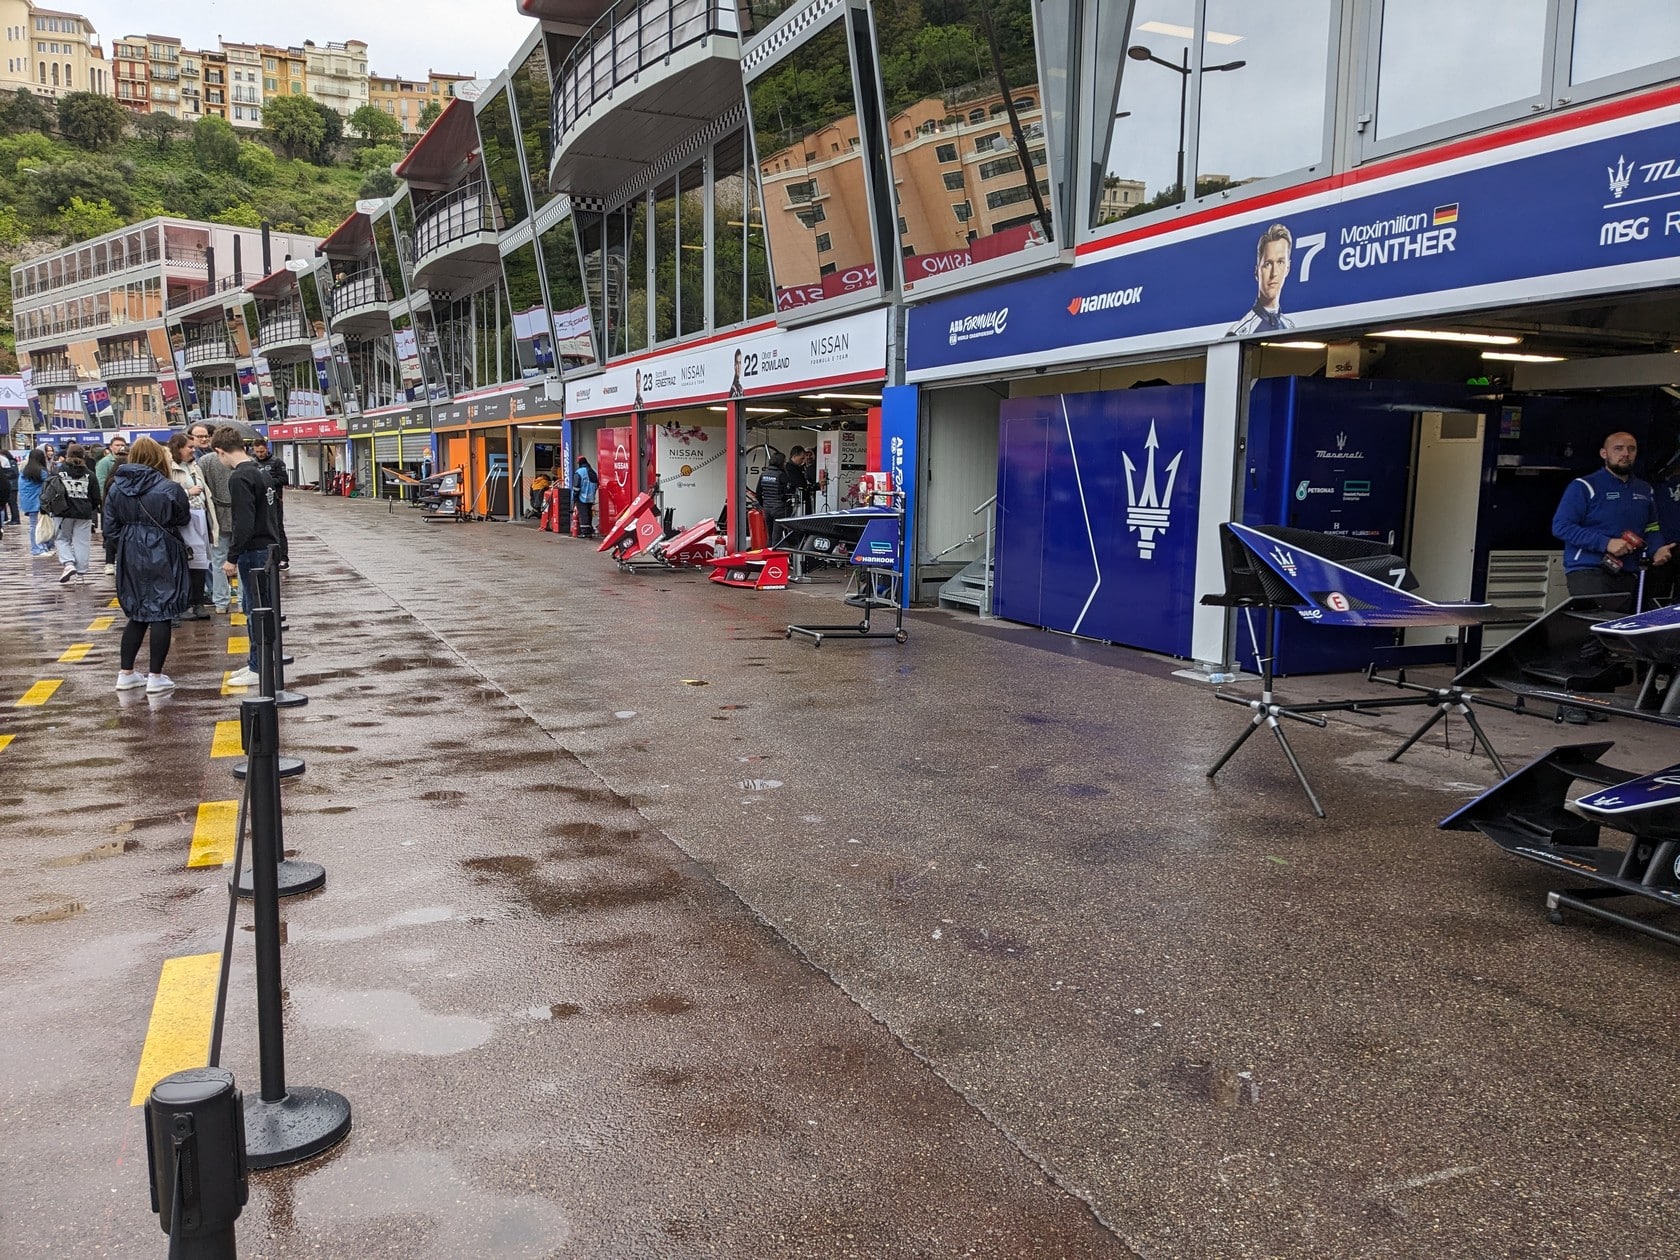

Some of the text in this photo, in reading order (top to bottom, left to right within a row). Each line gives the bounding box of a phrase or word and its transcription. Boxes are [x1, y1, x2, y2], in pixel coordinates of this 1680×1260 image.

[1340, 213, 1428, 245] Maximilian
[1600, 217, 1650, 246] MSG
[1296, 232, 1326, 283] 7
[1338, 227, 1457, 271] GÜNTHER
[949, 319, 963, 333] ABB
[962, 310, 997, 332] FORMULA
[810, 333, 849, 357] NISSAN
[680, 364, 705, 381] NISSAN
[743, 353, 758, 377] 22
[761, 357, 790, 372] ROWLAND
[643, 373, 653, 391] 23
[669, 449, 704, 457] NISSAN
[842, 453, 855, 462] 22
[1316, 450, 1364, 459] Maserati
[614, 462, 629, 470] NISSAN
[815, 539, 829, 550] FIA
[1389, 568, 1406, 590] 7
[1332, 596, 1345, 609] E
